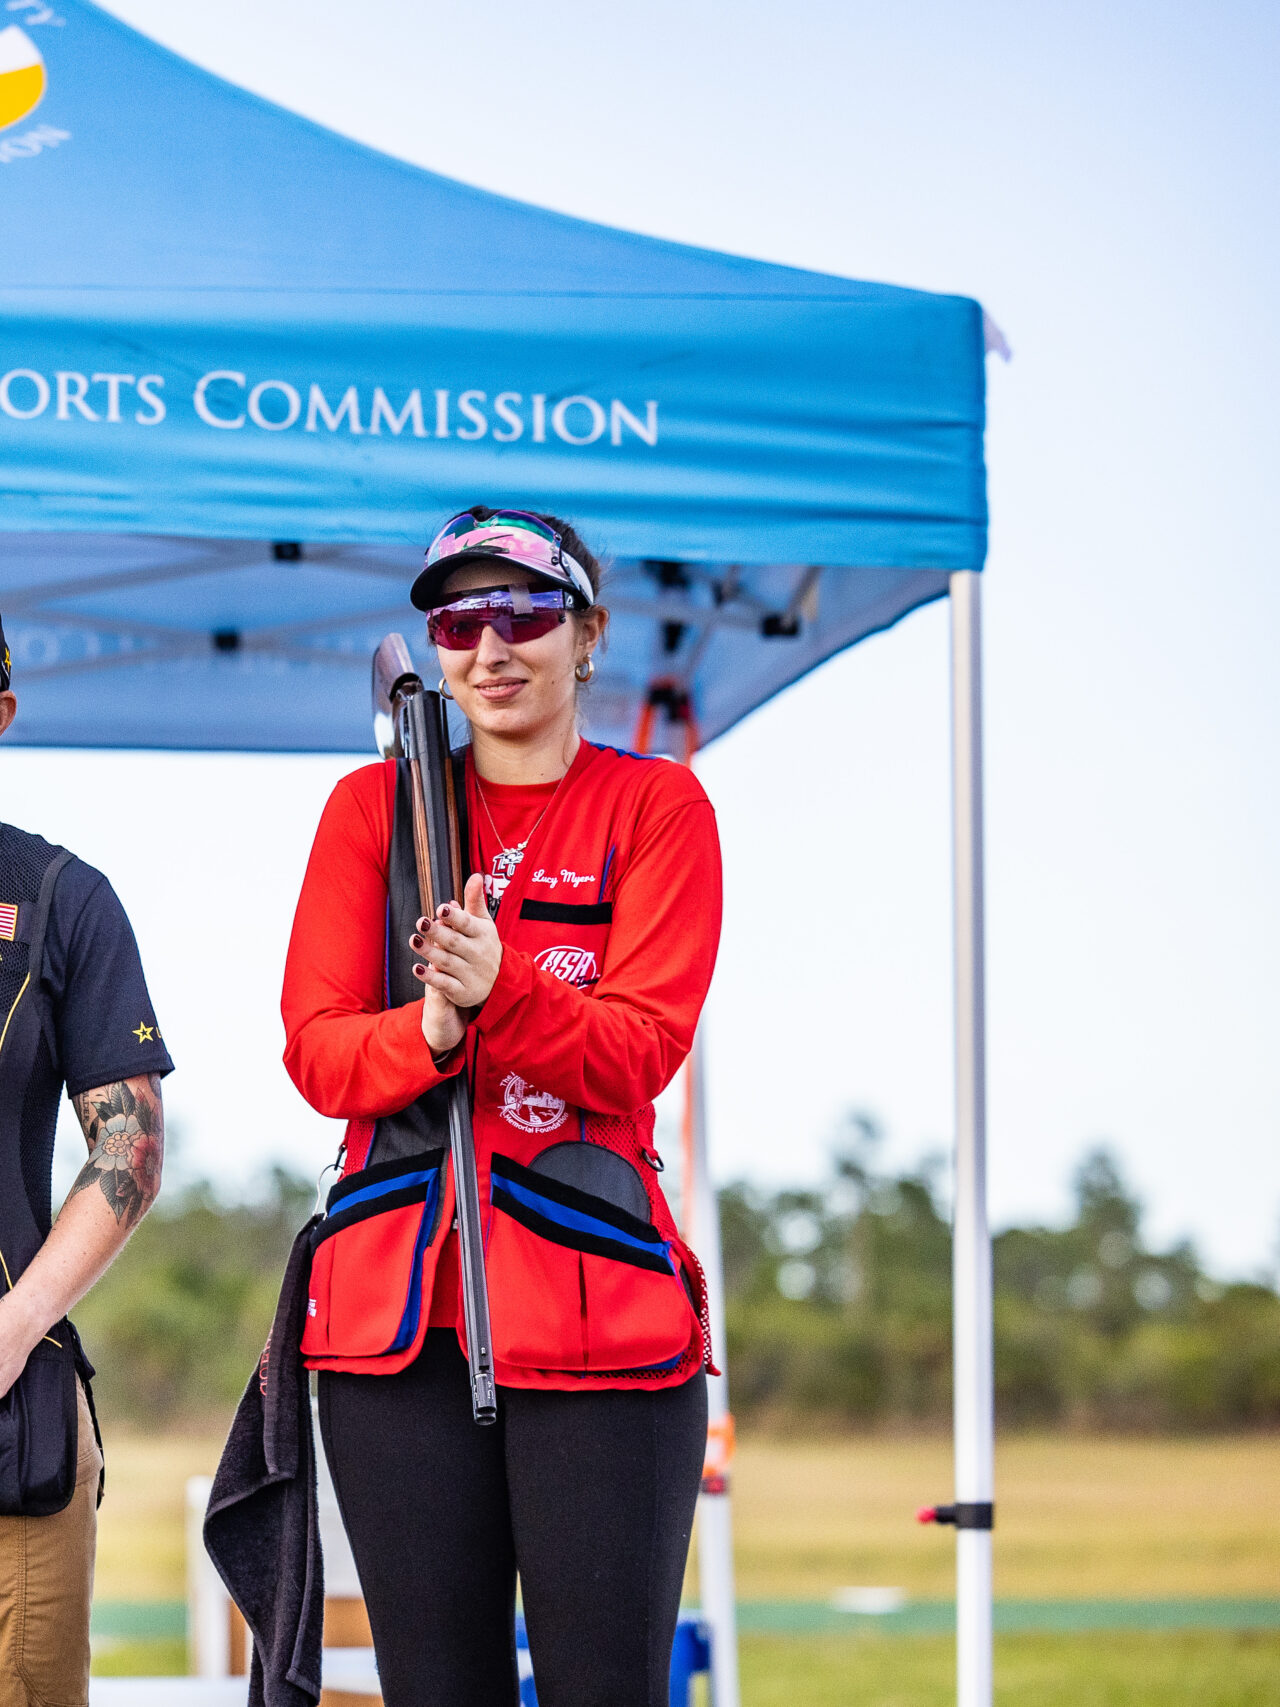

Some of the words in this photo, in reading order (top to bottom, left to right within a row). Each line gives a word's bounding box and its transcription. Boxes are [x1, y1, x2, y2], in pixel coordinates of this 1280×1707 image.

[193, 370, 660, 448] COMMISSION
[531, 868, 559, 889] Lucy
[560, 868, 596, 888] Myers
[540, 950, 596, 983] USA
[504, 1113, 535, 1134] Memorial
[535, 1112, 570, 1134] Foundation
